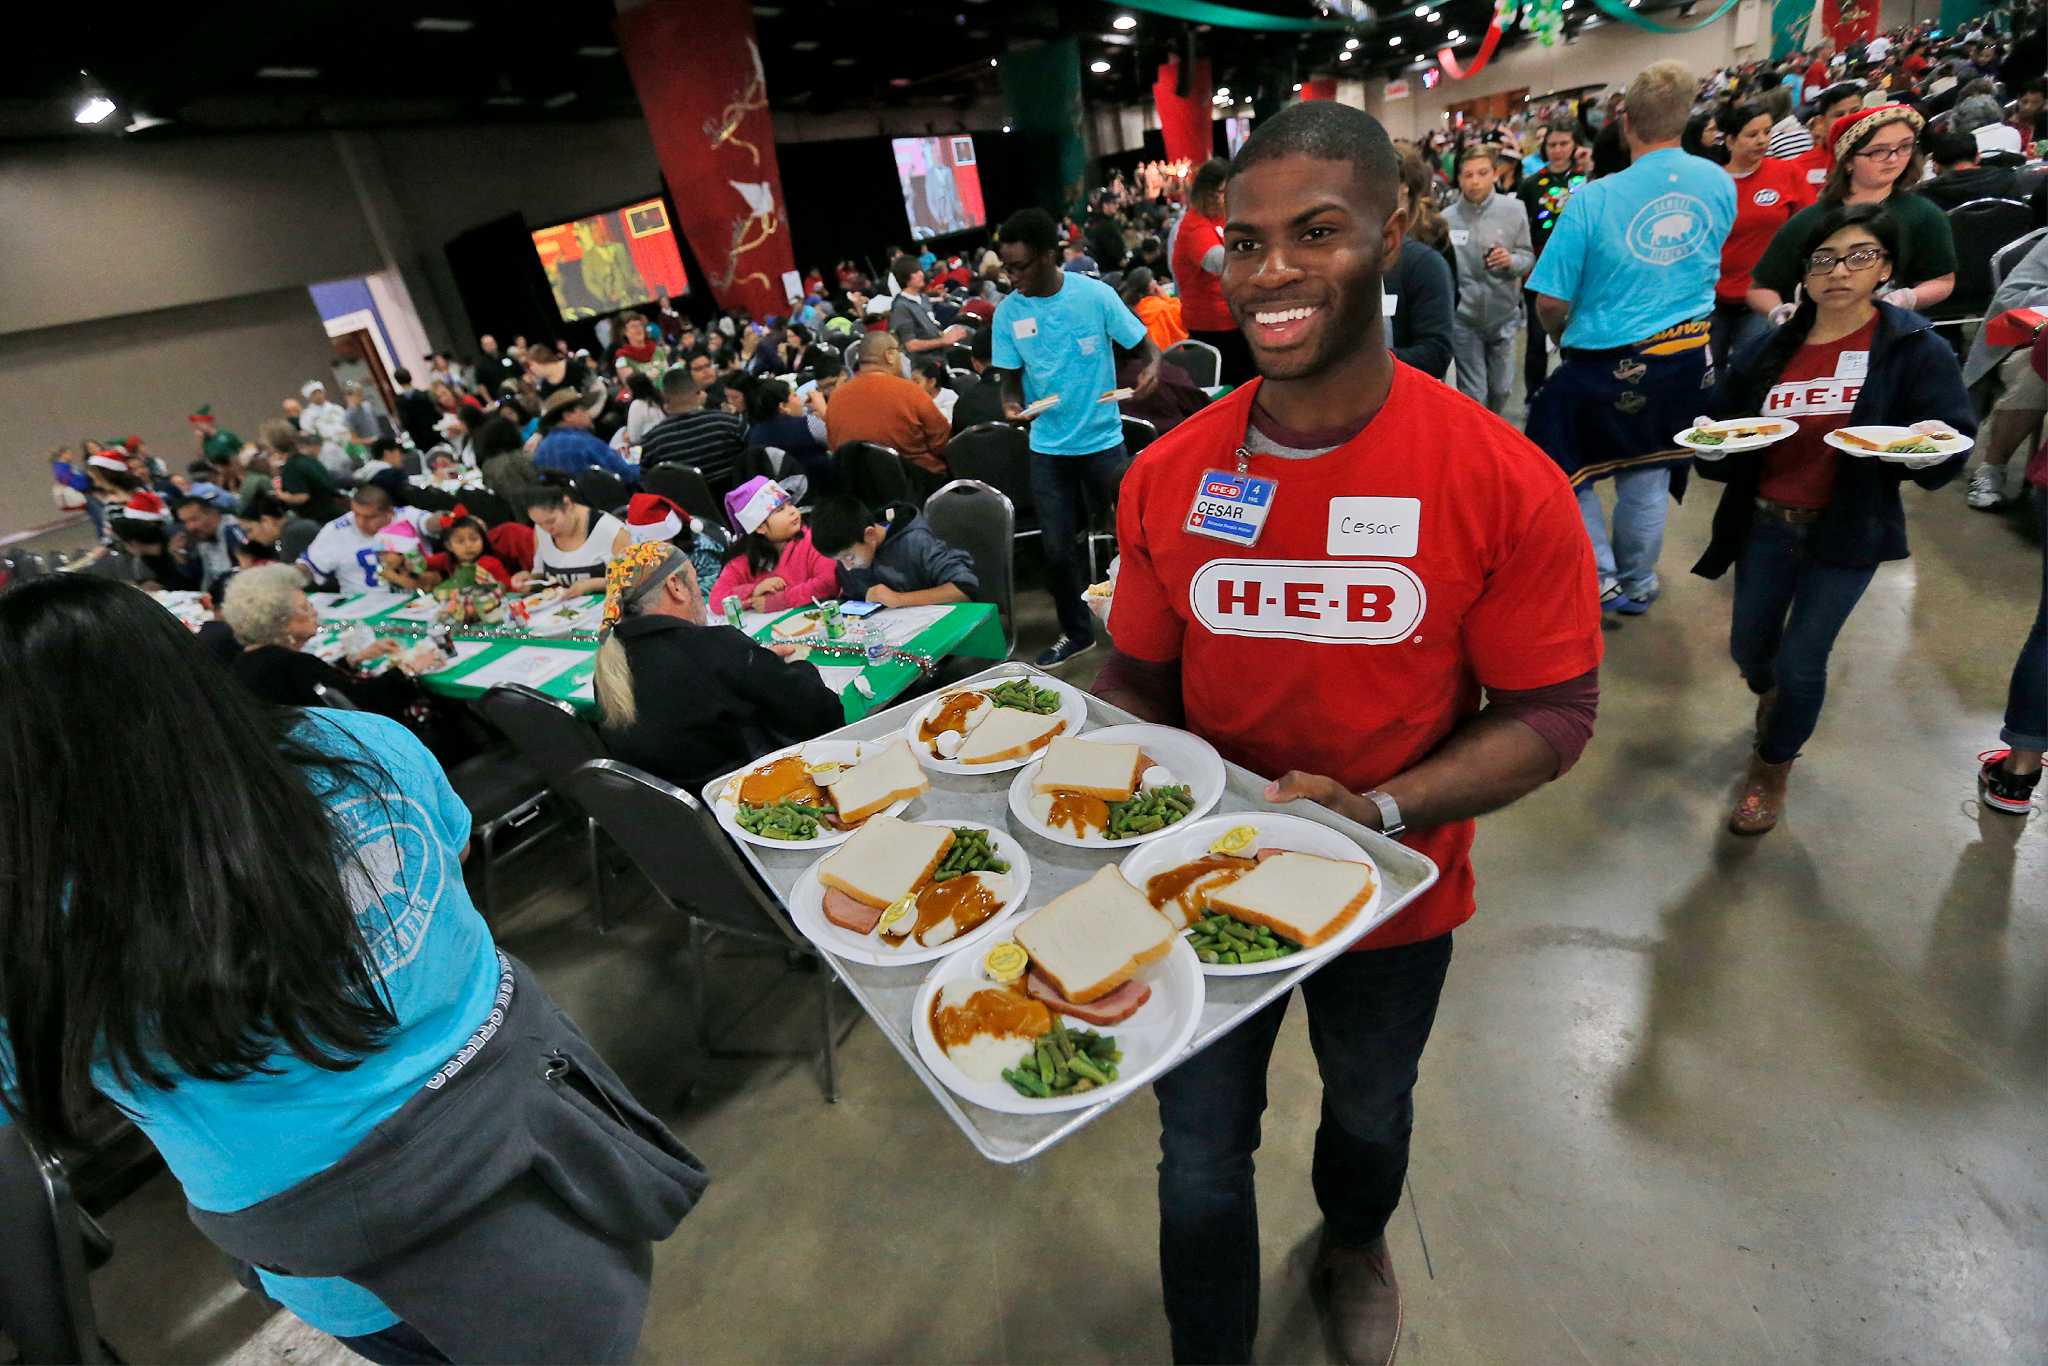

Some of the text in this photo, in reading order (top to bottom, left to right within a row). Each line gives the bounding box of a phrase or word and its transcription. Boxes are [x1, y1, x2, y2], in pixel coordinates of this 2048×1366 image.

[1209, 484, 1238, 496] H-E-B
[1252, 485, 1261, 495] 4
[1197, 501, 1244, 519] CESAR
[1340, 516, 1401, 536] Cesar
[1217, 579, 1396, 623] H-E-B
